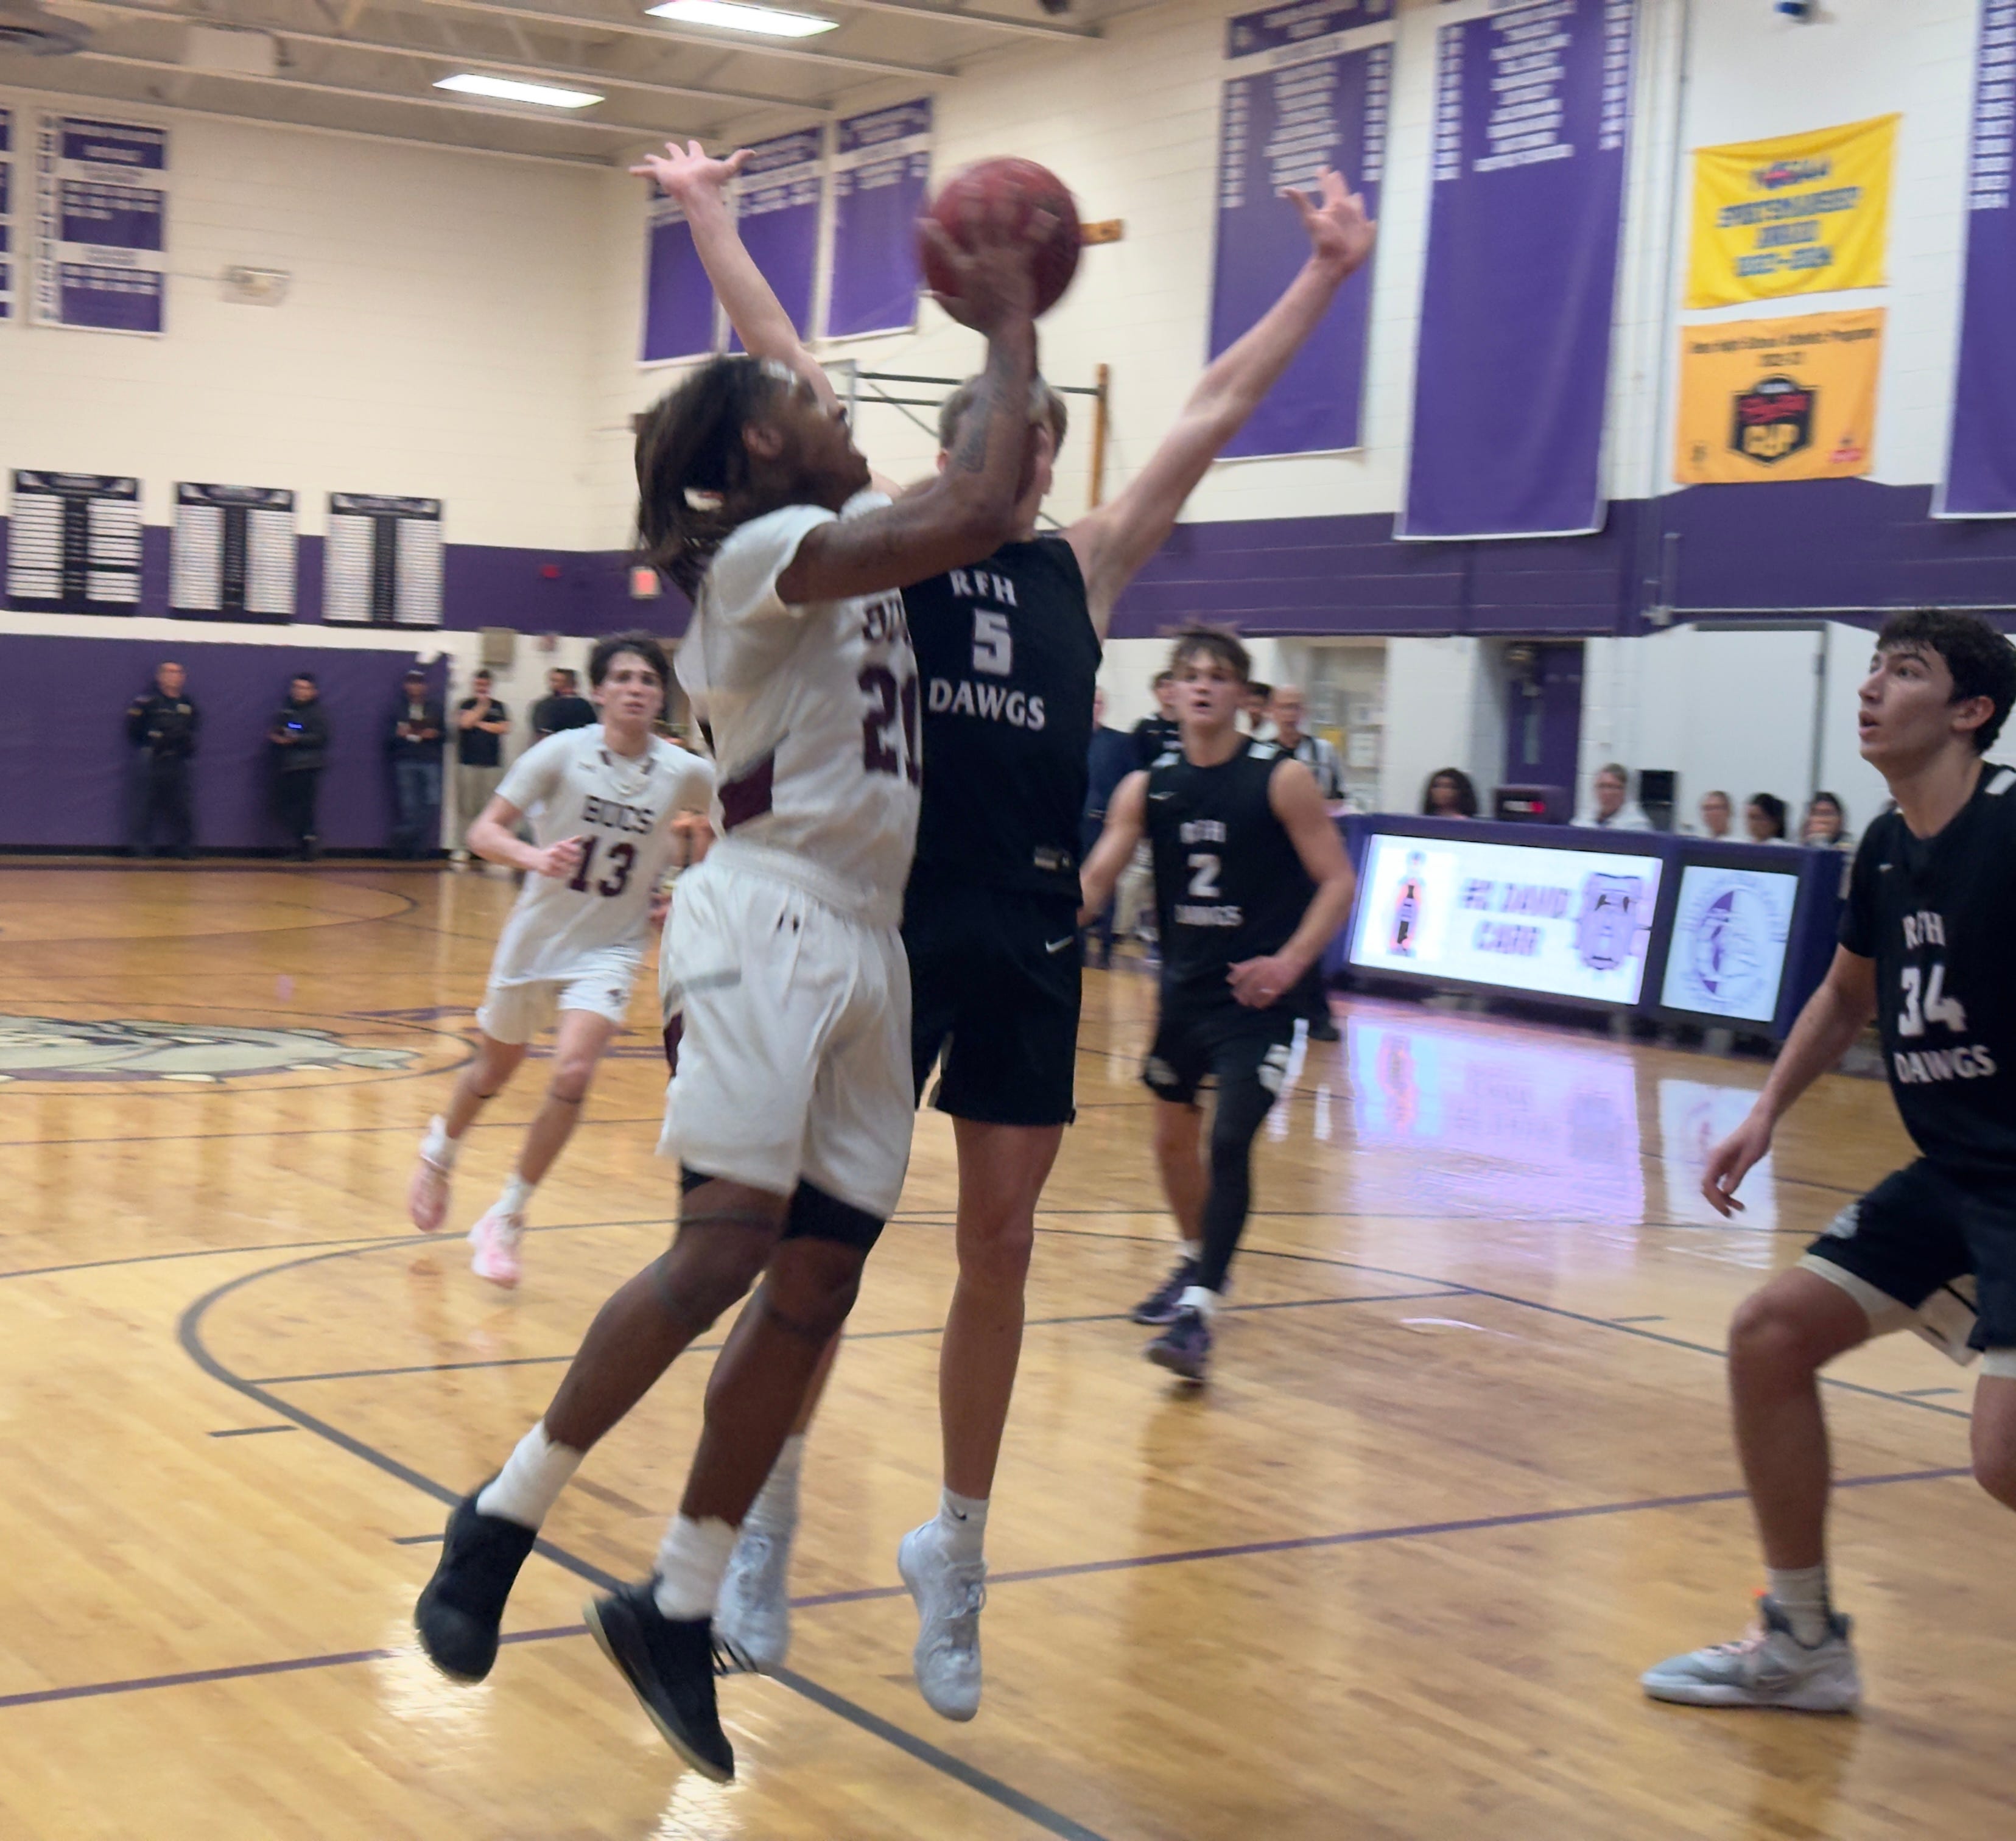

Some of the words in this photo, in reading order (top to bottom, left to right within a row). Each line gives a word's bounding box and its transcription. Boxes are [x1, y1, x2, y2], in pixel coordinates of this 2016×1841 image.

[949, 570, 1017, 606] RFH
[972, 608, 1011, 677] 5
[929, 678, 1046, 731] DAWGS
[569, 835, 637, 897] 13
[1187, 853, 1221, 898] 2
[1897, 964, 1967, 1037] 34
[1893, 1045, 1997, 1084] DAWGS
